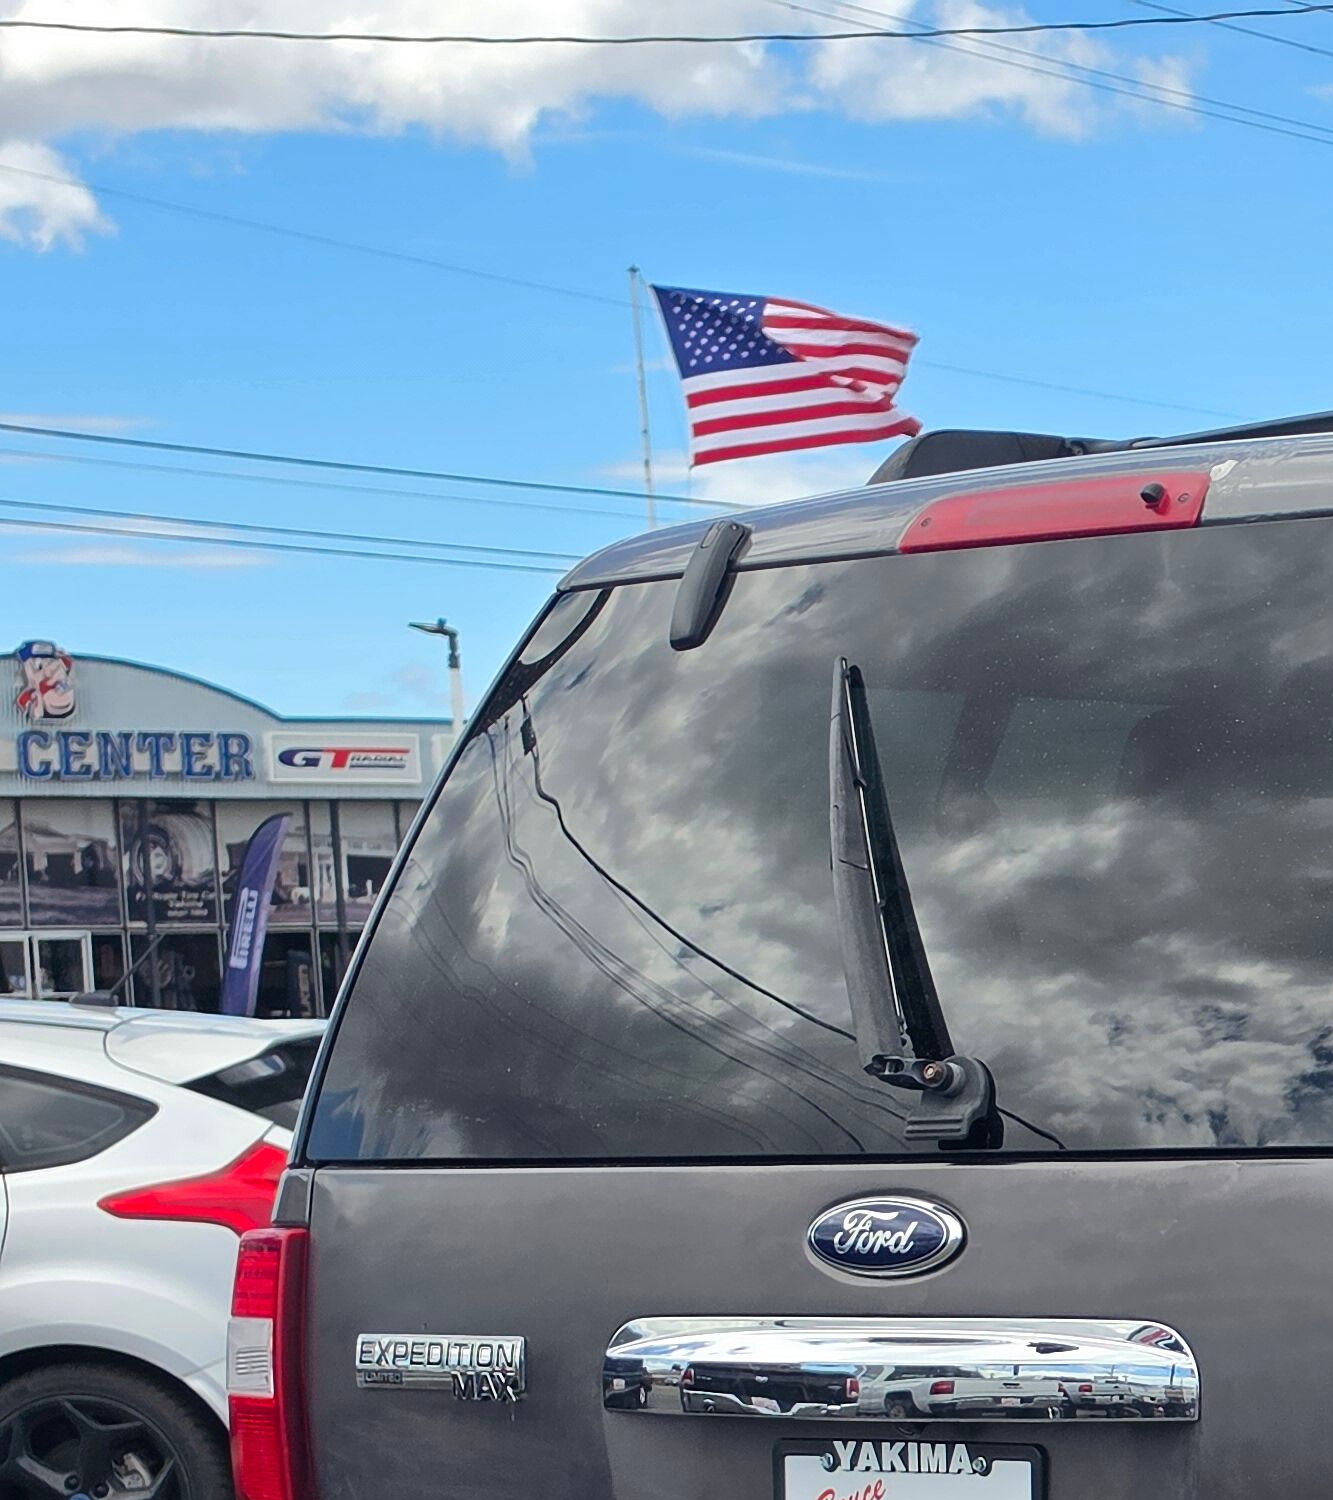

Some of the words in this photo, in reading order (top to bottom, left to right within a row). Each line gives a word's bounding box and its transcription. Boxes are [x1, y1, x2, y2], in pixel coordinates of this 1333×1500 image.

[17, 729, 255, 781] CENTER
[278, 747, 374, 768] GT
[229, 887, 258, 969] PIRELLI
[834, 1209, 918, 1254] Ford
[359, 1340, 516, 1367] EXPEDITION
[451, 1371, 516, 1402] MAX
[833, 1440, 973, 1474] YAKIMA
